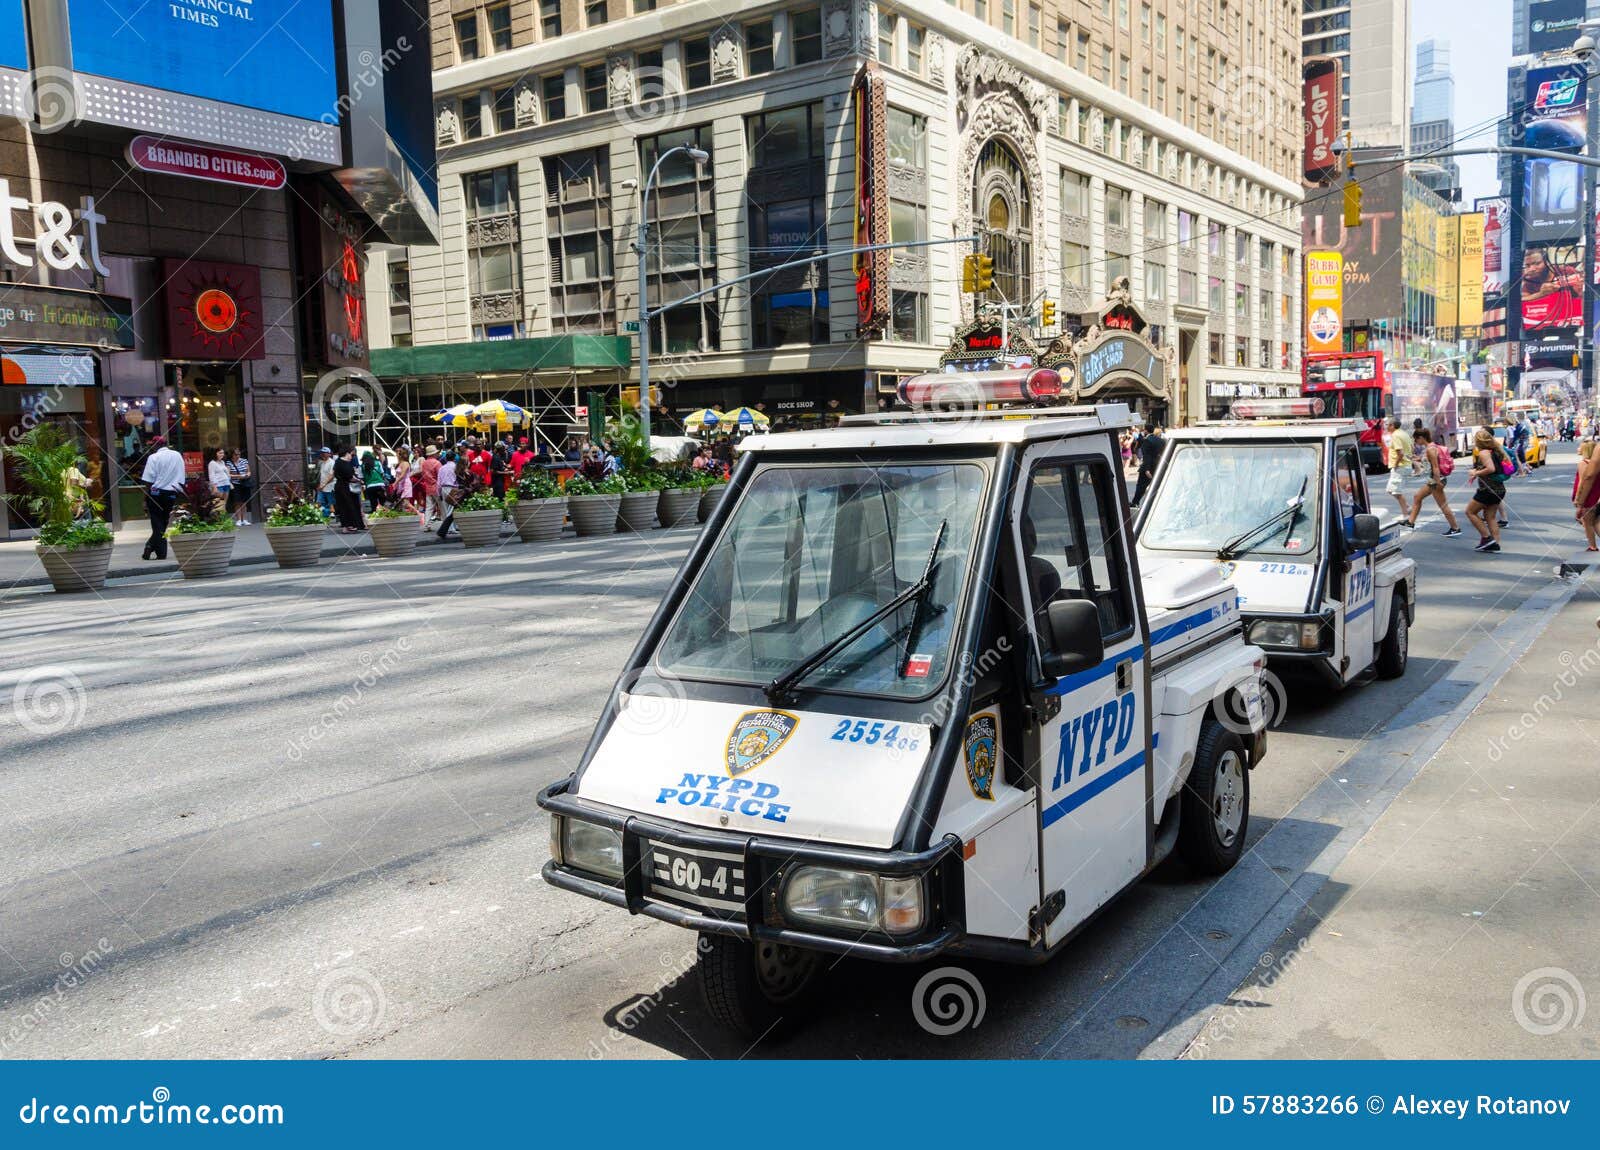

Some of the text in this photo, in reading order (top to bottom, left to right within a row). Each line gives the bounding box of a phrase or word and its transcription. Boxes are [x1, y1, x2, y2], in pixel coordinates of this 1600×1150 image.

[169, 4, 219, 28] TIMES
[147, 146, 276, 181] BRANDED CITIES.com
[1462, 246, 1482, 257] KING
[969, 336, 992, 348] Hard
[1260, 563, 1296, 574] 2712
[1348, 566, 1372, 606] NYPD
[738, 720, 791, 735] DEPARTMENT
[754, 713, 787, 723] POLICE
[831, 719, 901, 748] 2554
[1052, 692, 1136, 792] NYPD
[678, 773, 781, 800] NYPD
[656, 788, 792, 823] POLICE
[672, 857, 728, 895] GO-4
